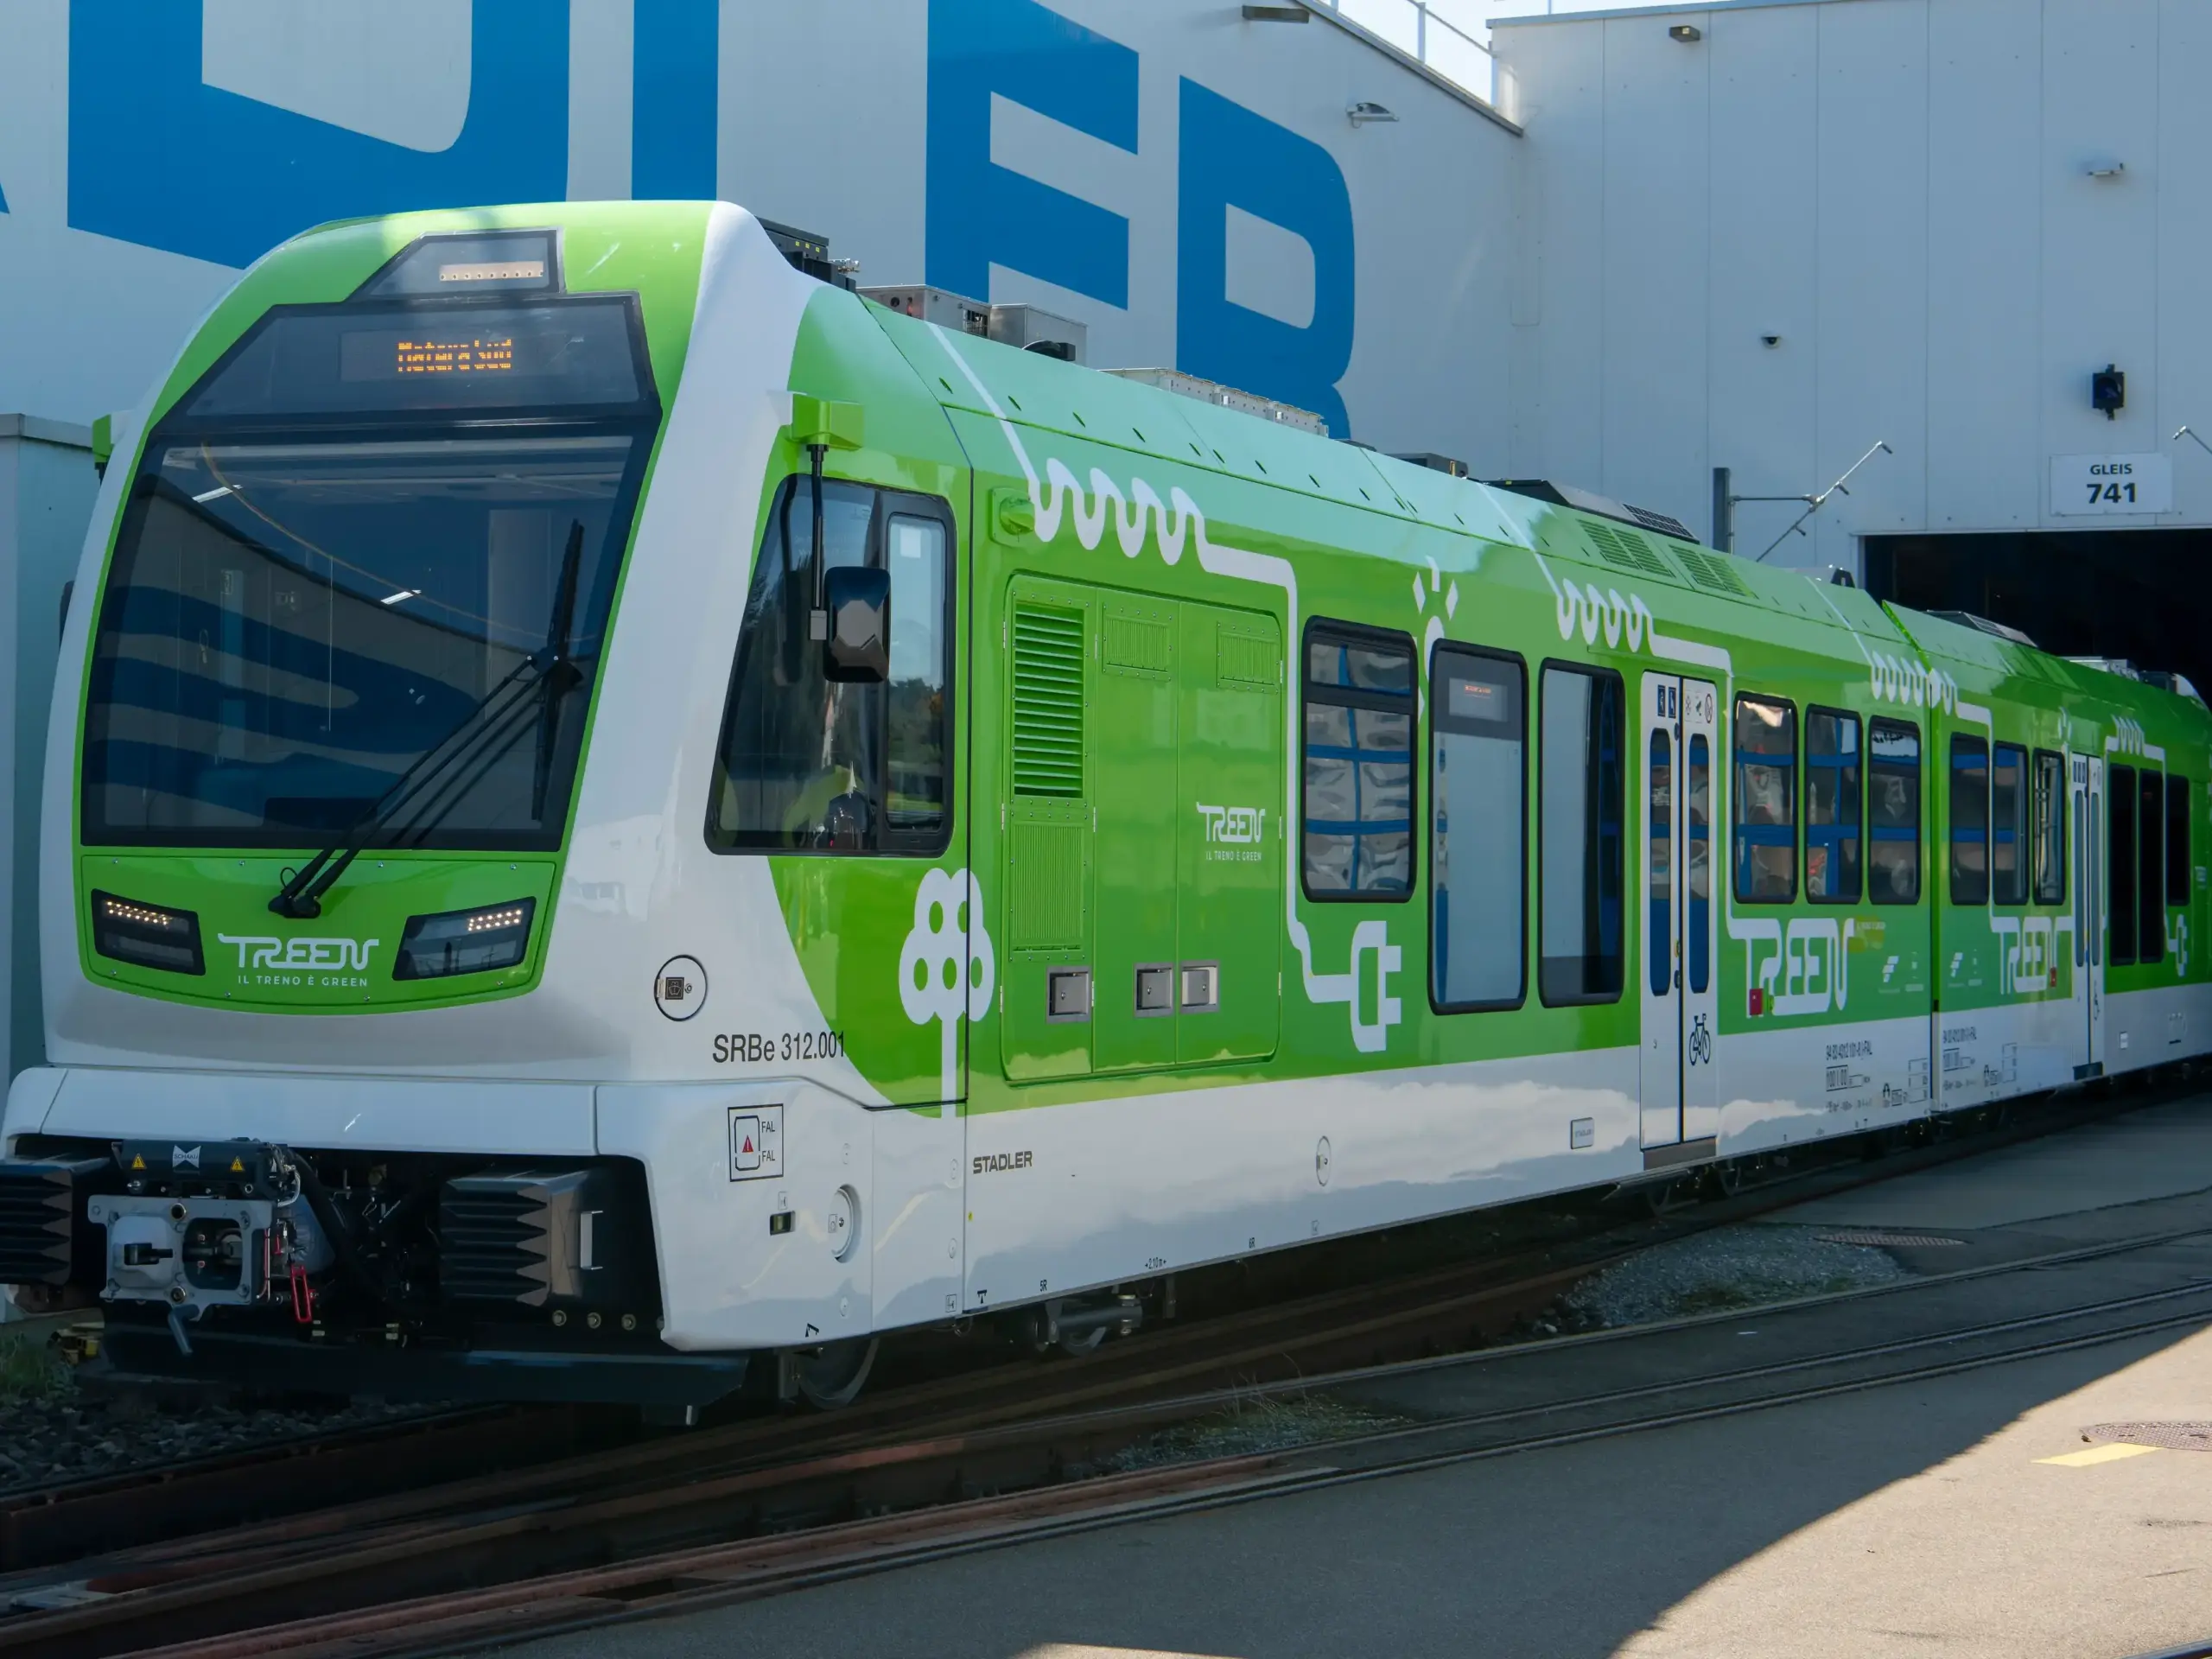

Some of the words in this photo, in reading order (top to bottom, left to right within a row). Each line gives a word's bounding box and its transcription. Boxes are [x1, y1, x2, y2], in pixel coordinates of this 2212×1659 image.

[2089, 463, 2133, 475] GLEIS
[2086, 482, 2136, 504] 741
[1196, 801, 1266, 843] TREEN
[217, 932, 380, 971] TREEN
[1726, 918, 1854, 1019] TREEN
[238, 975, 250, 984] IL
[257, 976, 302, 985] TRENO
[308, 974, 315, 986] È
[321, 976, 368, 987] GREEN
[712, 1033, 775, 1064] SRBe
[781, 1030, 845, 1061] 312.001
[761, 1121, 775, 1133] FAL
[761, 1149, 775, 1162] FAL
[973, 1150, 1033, 1174] STADLER
